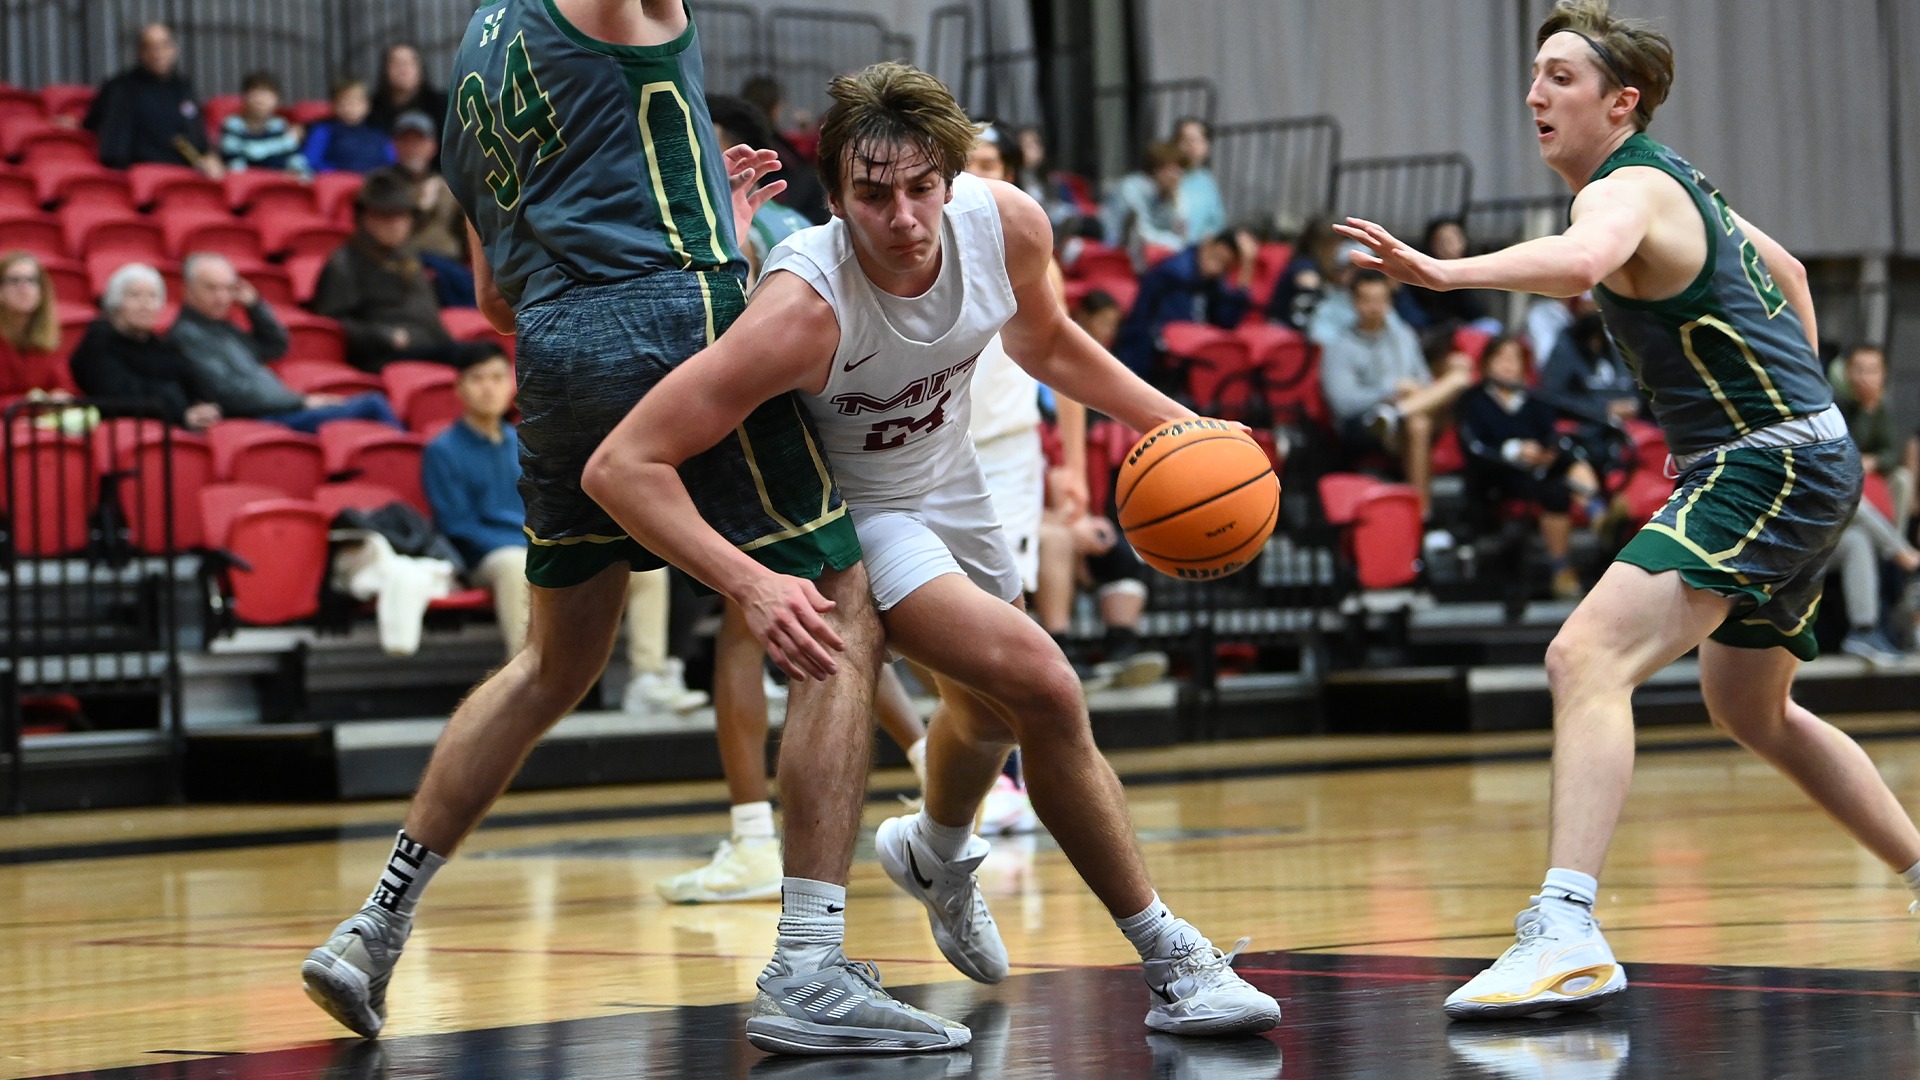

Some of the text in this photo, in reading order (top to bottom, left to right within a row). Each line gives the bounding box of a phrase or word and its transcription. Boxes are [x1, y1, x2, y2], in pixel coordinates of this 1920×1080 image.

[457, 29, 568, 212] 34
[829, 350, 984, 416] MIT
[1205, 520, 1237, 538] MIT
[372, 832, 429, 913] ELITE
